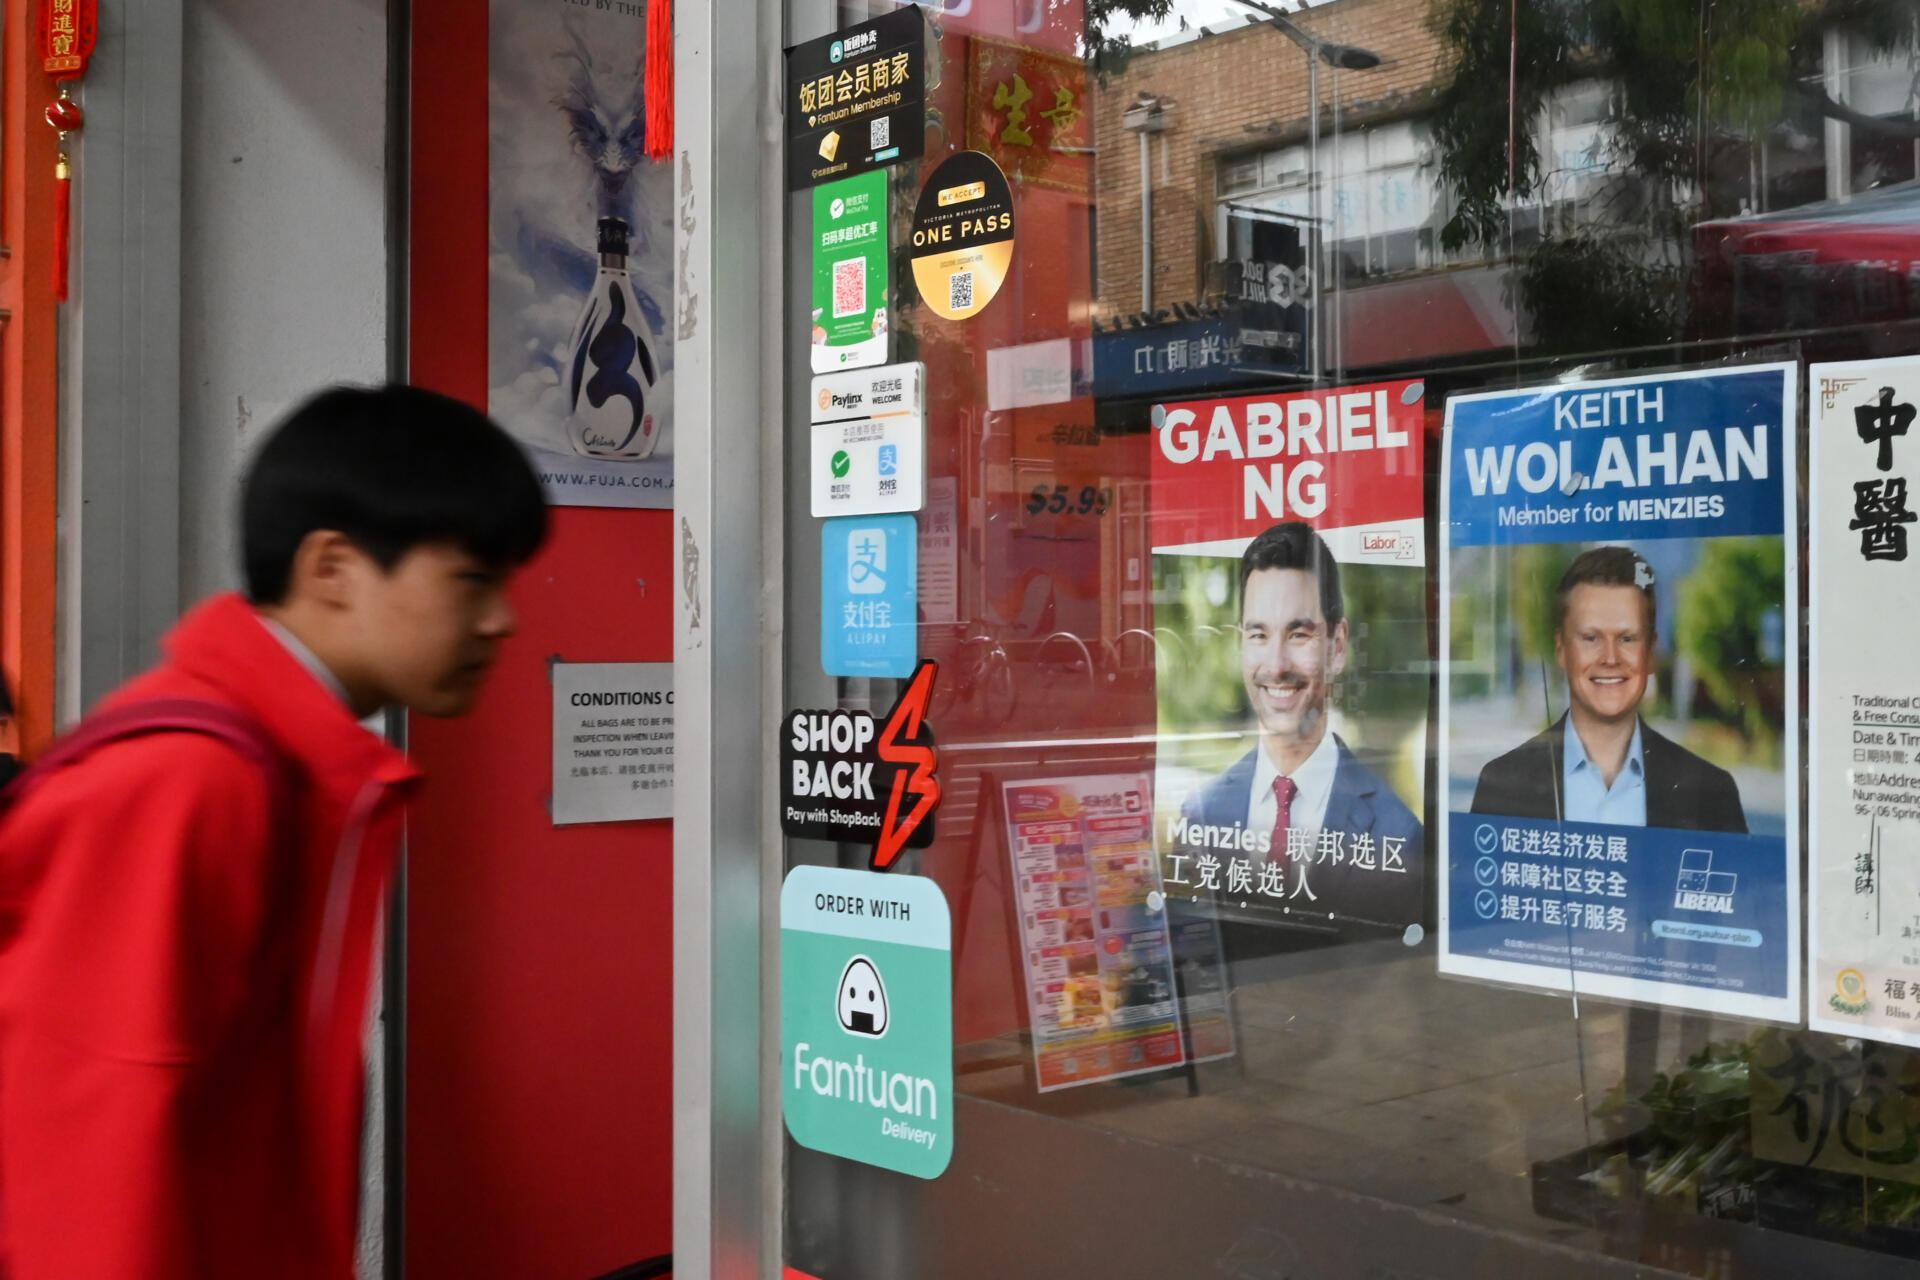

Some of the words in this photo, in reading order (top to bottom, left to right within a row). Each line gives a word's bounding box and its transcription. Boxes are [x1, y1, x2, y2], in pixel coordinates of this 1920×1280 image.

[616, 1, 645, 18] THE
[800, 52, 910, 113] 饭团会员商家
[817, 106, 849, 126] Fantuan
[850, 91, 901, 114] Membership
[954, 186, 982, 200] ACCEPT
[913, 224, 953, 247] ONE
[961, 212, 1011, 238] PASS
[924, 213, 953, 224] VICTORIA
[956, 203, 1001, 217] METROPOLITAN
[831, 393, 863, 409] Paylinx
[872, 394, 902, 405] WELCOME
[1554, 386, 1664, 431] KEITH
[1159, 390, 1409, 464] GABRIEL
[1464, 424, 1769, 497] WOLAHAN
[1849, 386, 1918, 561] 中醫
[1026, 484, 1113, 516] $5.99
[1244, 460, 1327, 520] NG
[1499, 503, 1579, 527] Member
[1584, 502, 1614, 522] for
[1618, 495, 1725, 522] MENZIES
[1363, 535, 1396, 550] Labor
[842, 601, 891, 629] 支付宝
[847, 632, 887, 645] ALIPAY
[571, 691, 662, 706] CONDITIONS
[1852, 694, 1910, 709] Traditional
[581, 719, 596, 728] ALL
[597, 719, 619, 728] BAGS
[620, 718, 636, 727] ARE
[637, 718, 649, 726] TO
[650, 718, 661, 726] BE
[1853, 710, 1862, 722] &
[1864, 710, 1888, 722] Free
[573, 733, 621, 743] INSPECTION
[623, 732, 649, 742] WHEN
[791, 713, 875, 754] SHOP
[1853, 730, 1884, 745] Date
[1886, 732, 1897, 745] &
[574, 749, 602, 759] THANK
[604, 748, 621, 757] YOU
[623, 747, 640, 756] FOR
[641, 746, 663, 756] YOUR
[792, 760, 875, 800] BACK
[786, 805, 806, 824] Pay
[807, 807, 829, 824] with
[829, 809, 881, 828] ShopBack
[1166, 816, 1271, 853] Menzies
[1284, 827, 1408, 874] 联邦选区
[1501, 827, 1628, 864] 促进经济发展
[1163, 853, 1318, 902] 工党候选人
[1500, 861, 1628, 898] 保障社区安全
[815, 892, 864, 917] ORDER
[870, 898, 911, 921] WITH
[1500, 897, 1628, 933] 提升医疗服务
[1674, 892, 1734, 914] LIBERAL
[794, 1042, 937, 1120] Fantuan
[881, 1117, 936, 1150] Delivery
